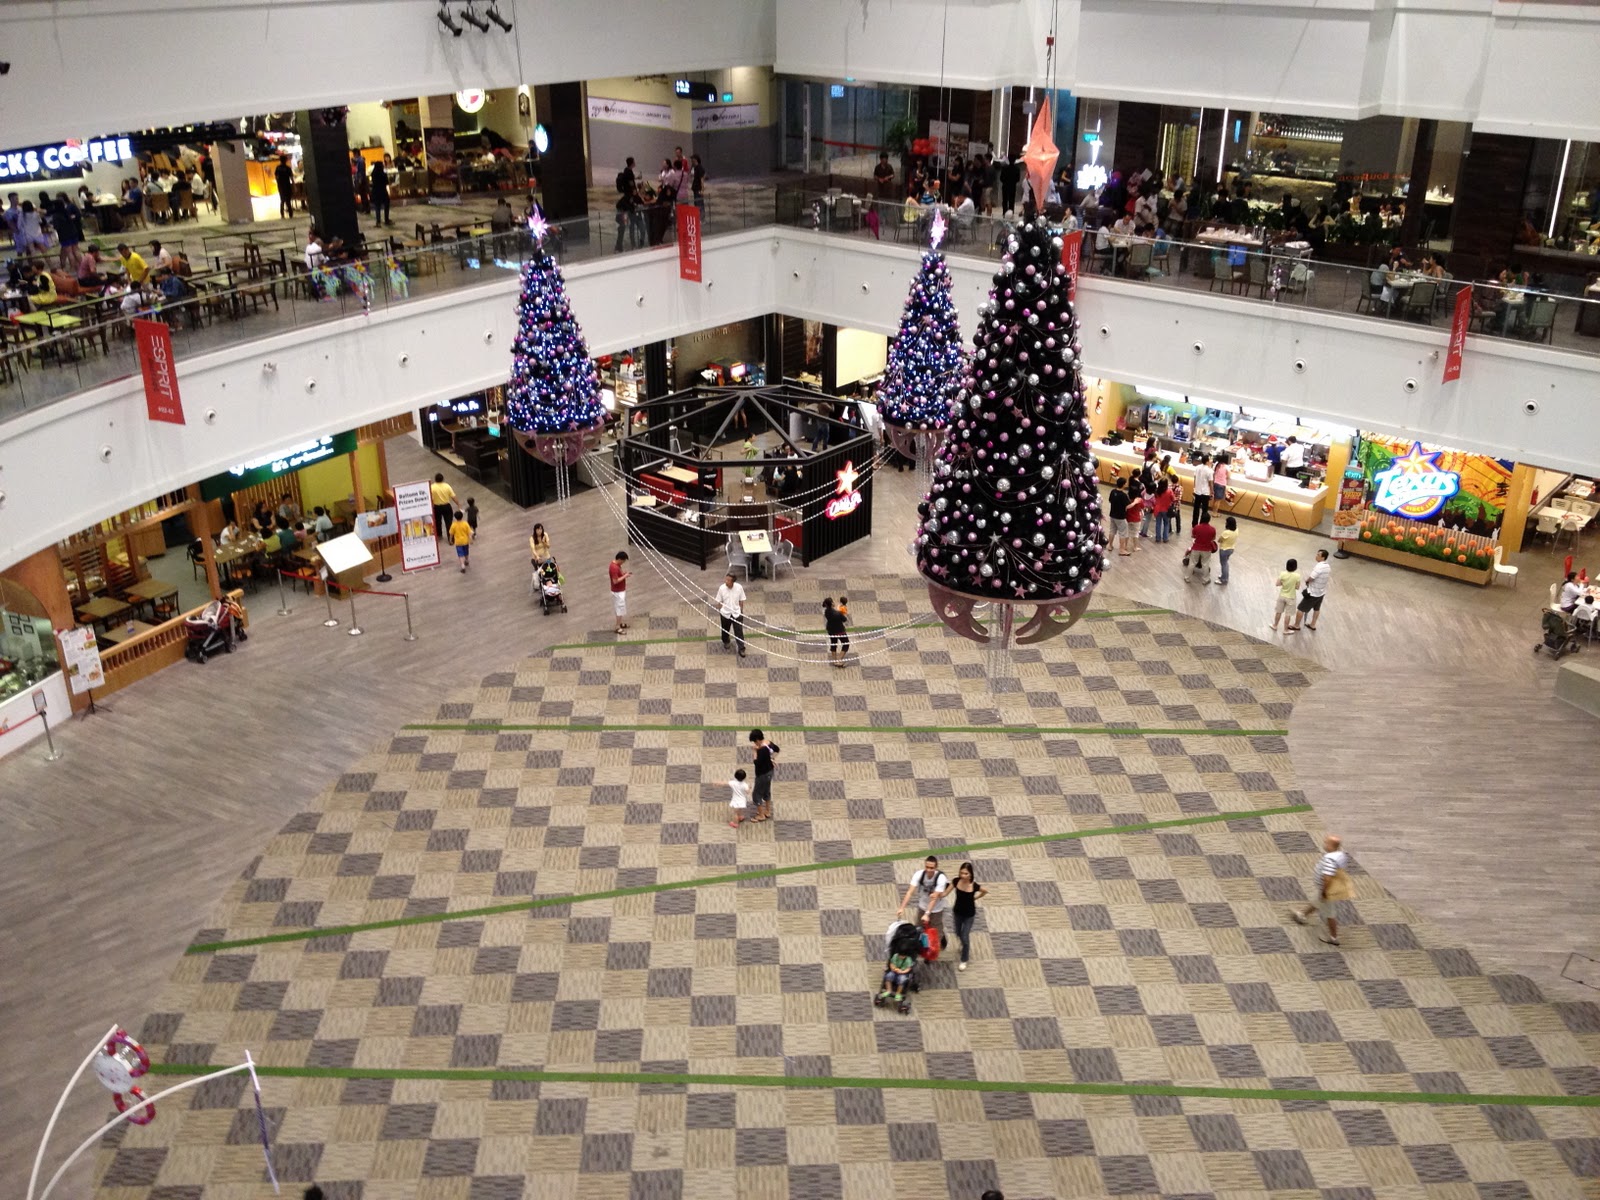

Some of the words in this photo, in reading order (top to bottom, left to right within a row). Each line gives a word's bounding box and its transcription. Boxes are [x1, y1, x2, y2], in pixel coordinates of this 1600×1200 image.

[685, 214, 698, 265] ESPRIT
[150, 335, 174, 401] ESPRIT
[1374, 469, 1458, 500] Texas
